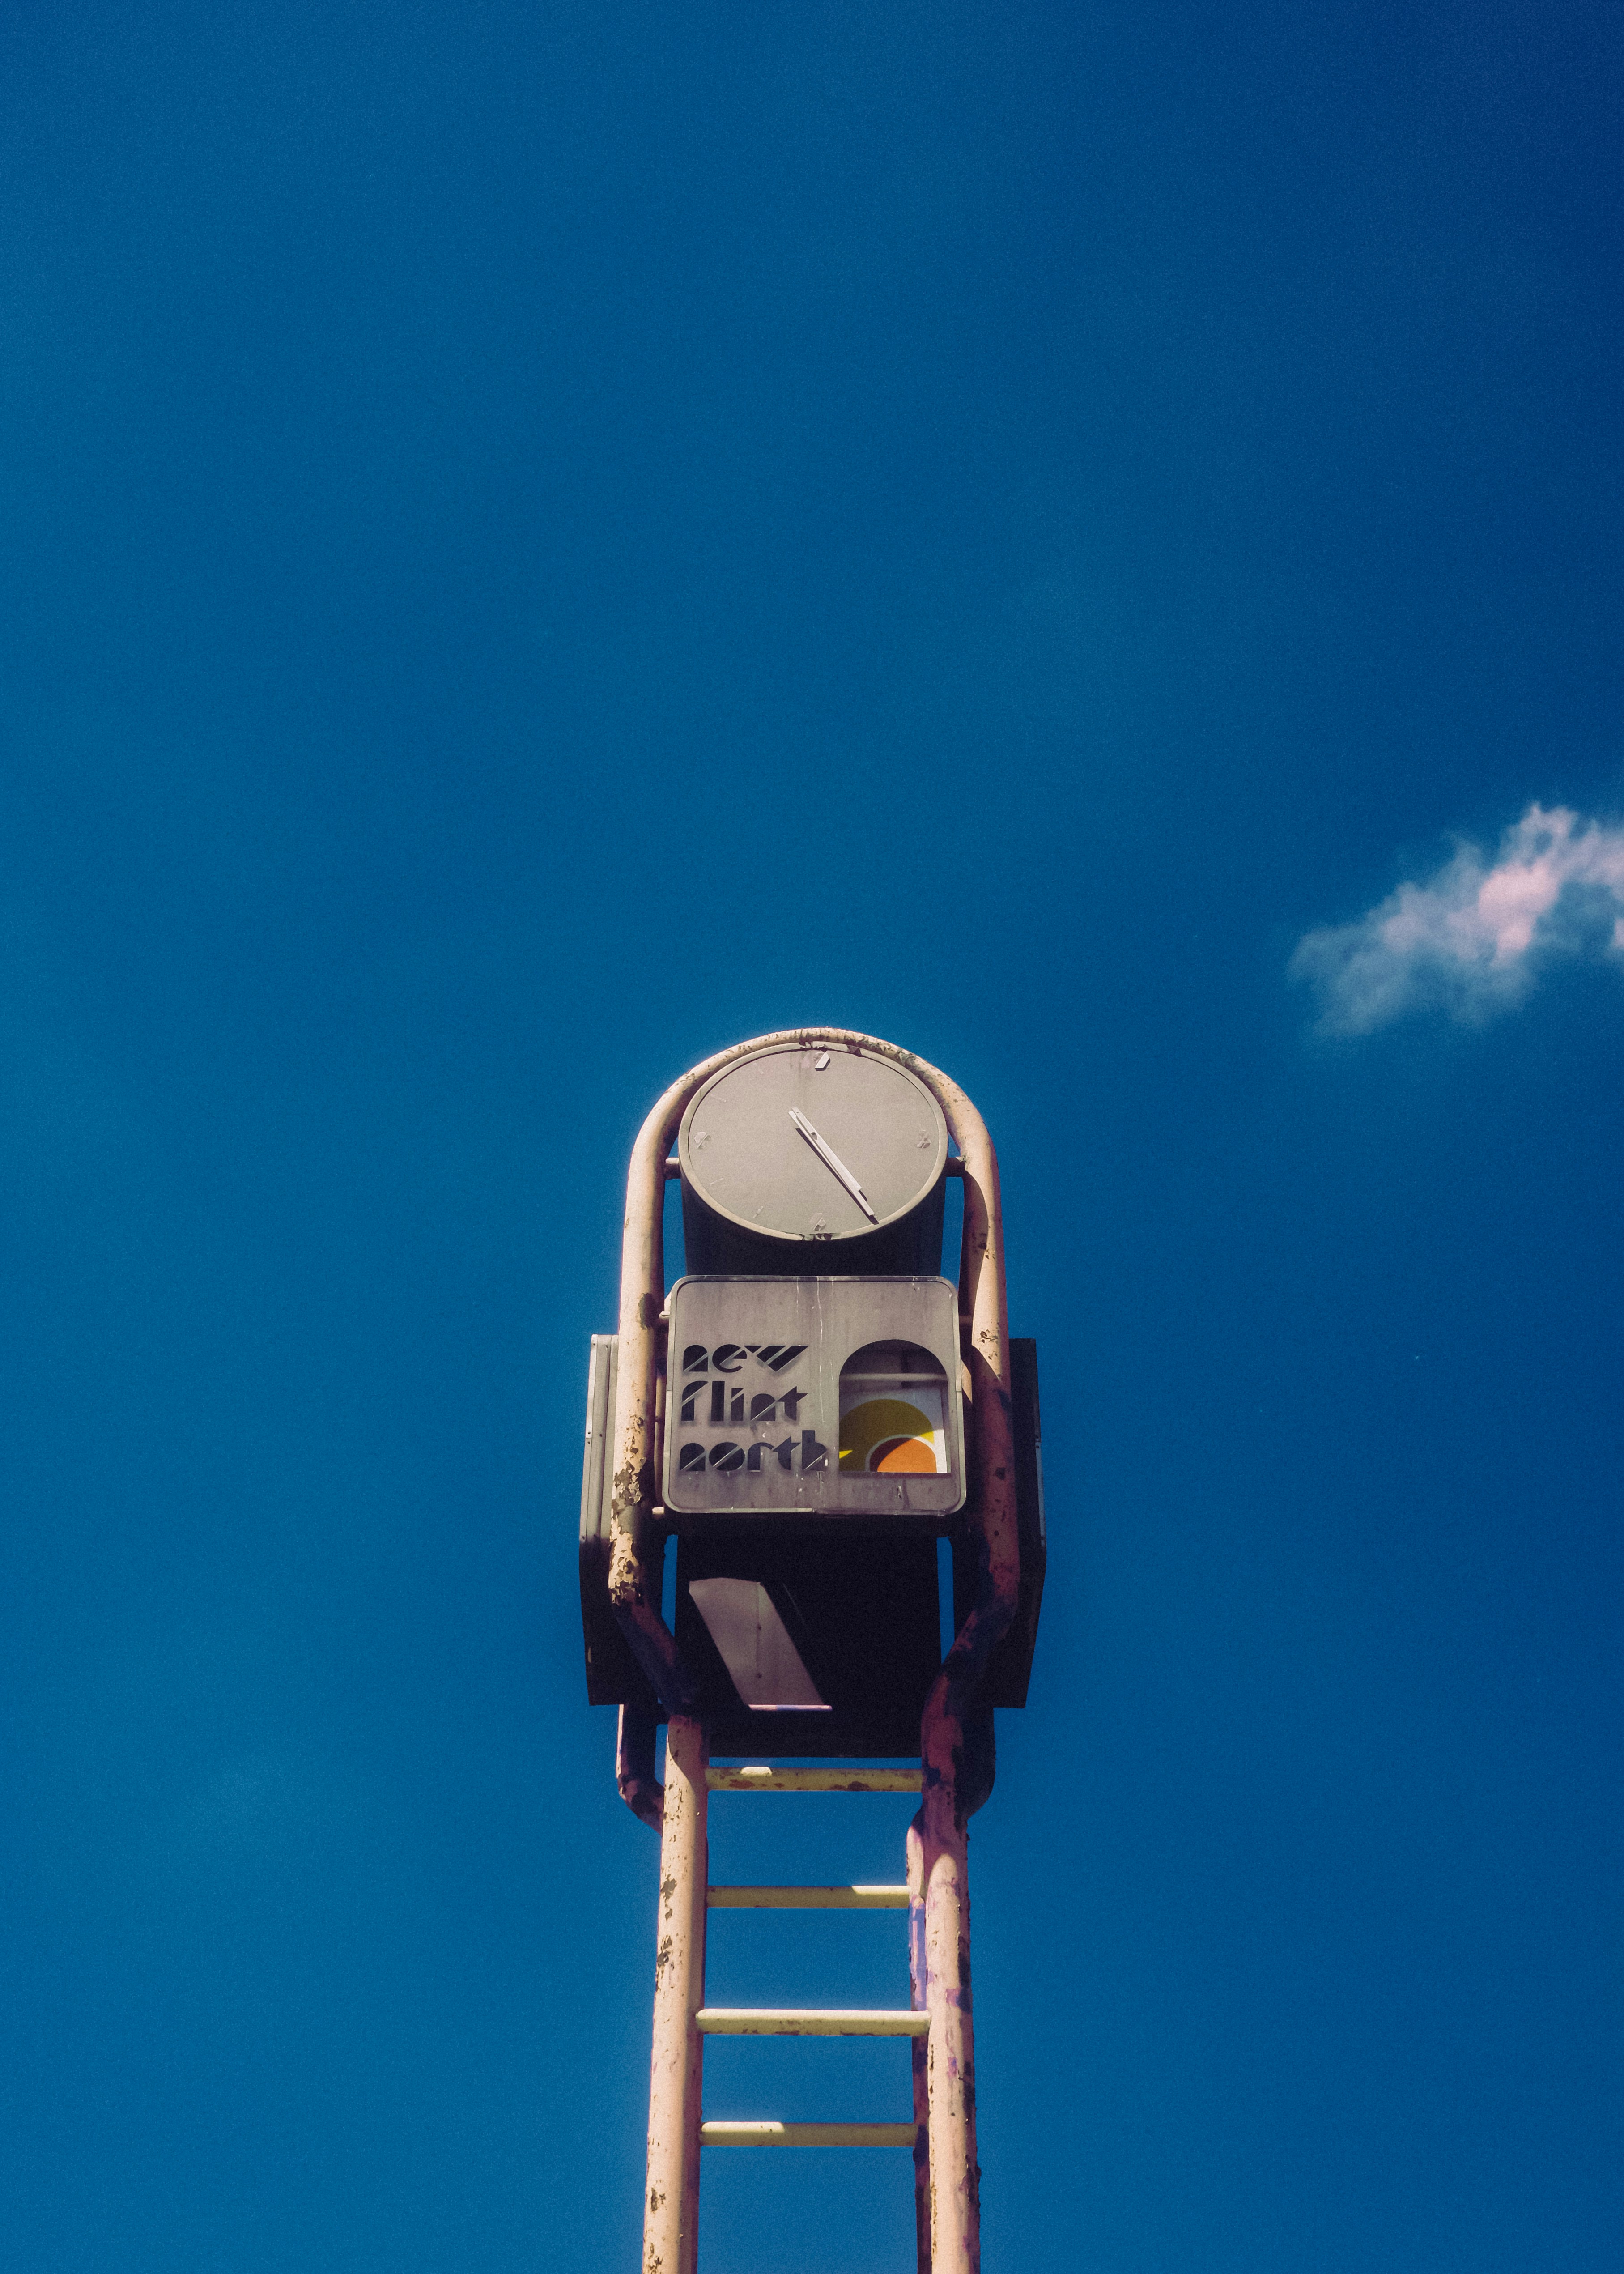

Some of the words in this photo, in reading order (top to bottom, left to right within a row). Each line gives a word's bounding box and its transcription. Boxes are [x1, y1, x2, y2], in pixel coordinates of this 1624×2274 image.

[683, 1344, 809, 1372] new
[681, 1380, 808, 1422] flint
[680, 1430, 829, 1472] north
